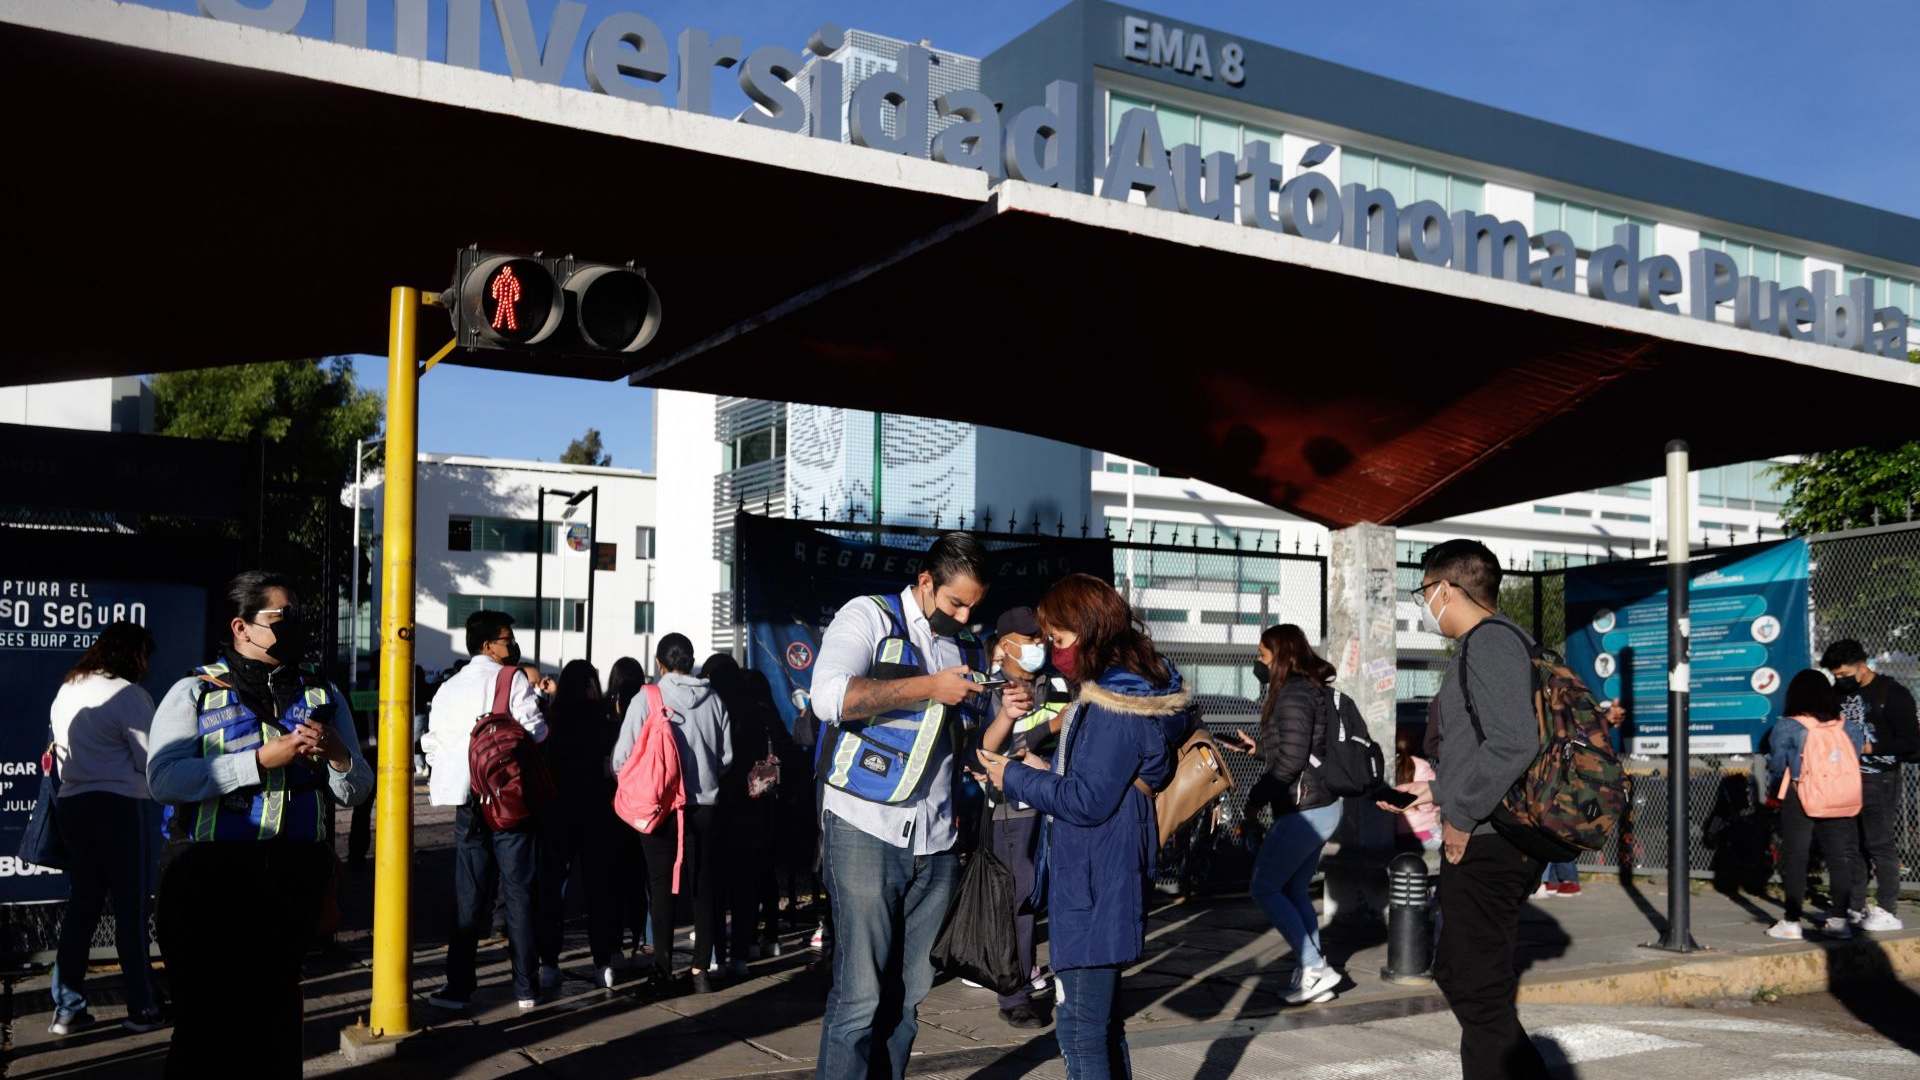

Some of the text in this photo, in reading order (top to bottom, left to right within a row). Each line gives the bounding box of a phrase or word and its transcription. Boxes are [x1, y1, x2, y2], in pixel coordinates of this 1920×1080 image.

[1124, 15, 1245, 84] EMA 8
[1100, 107, 1576, 295] Autónoma
[1587, 224, 1682, 316] de
[1689, 247, 1908, 361] Puebla
[3, 580, 89, 598] PTURA EL
[31, 633, 67, 648] BUAP
[0, 762, 37, 776] GAR
